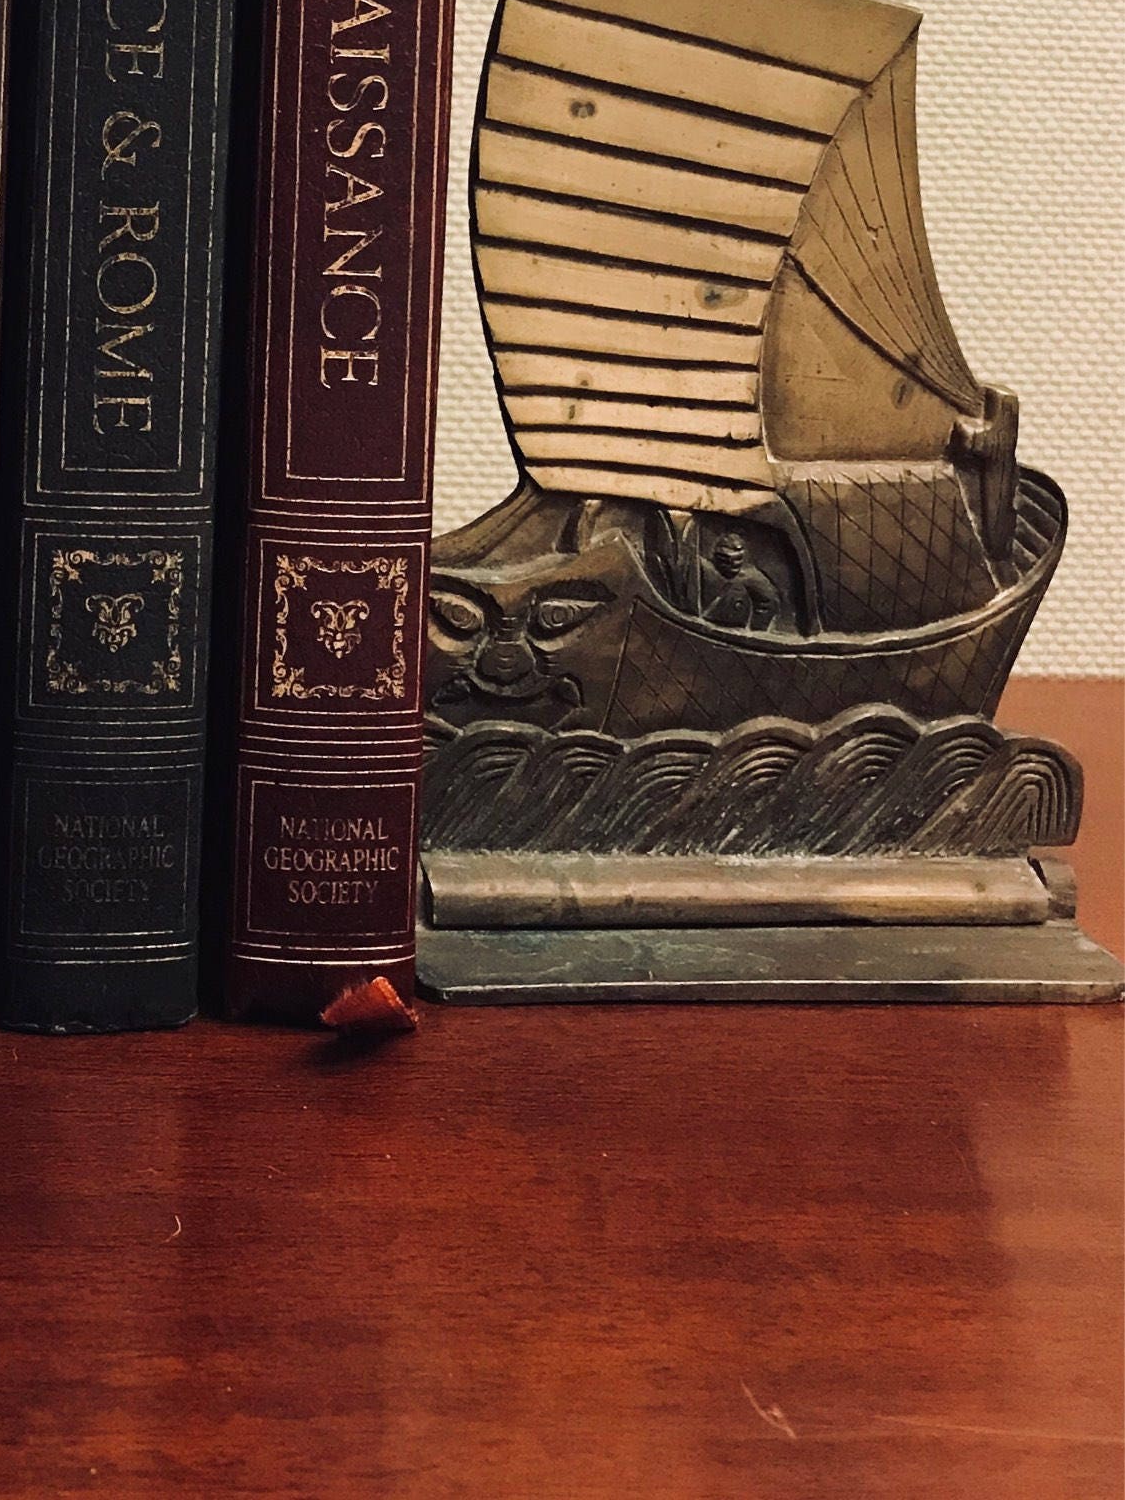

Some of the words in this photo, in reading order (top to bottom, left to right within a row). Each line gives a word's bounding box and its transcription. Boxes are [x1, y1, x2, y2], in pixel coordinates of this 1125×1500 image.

[100, 110, 162, 183] &
[92, 201, 161, 436] ROME
[54, 813, 165, 839] NATIONAL
[38, 844, 175, 870] GEOGRAPHIC
[264, 846, 400, 873] GEOGRAPHIC
[62, 878, 152, 904] SOCIETY
[288, 880, 379, 905] SOCIETY
